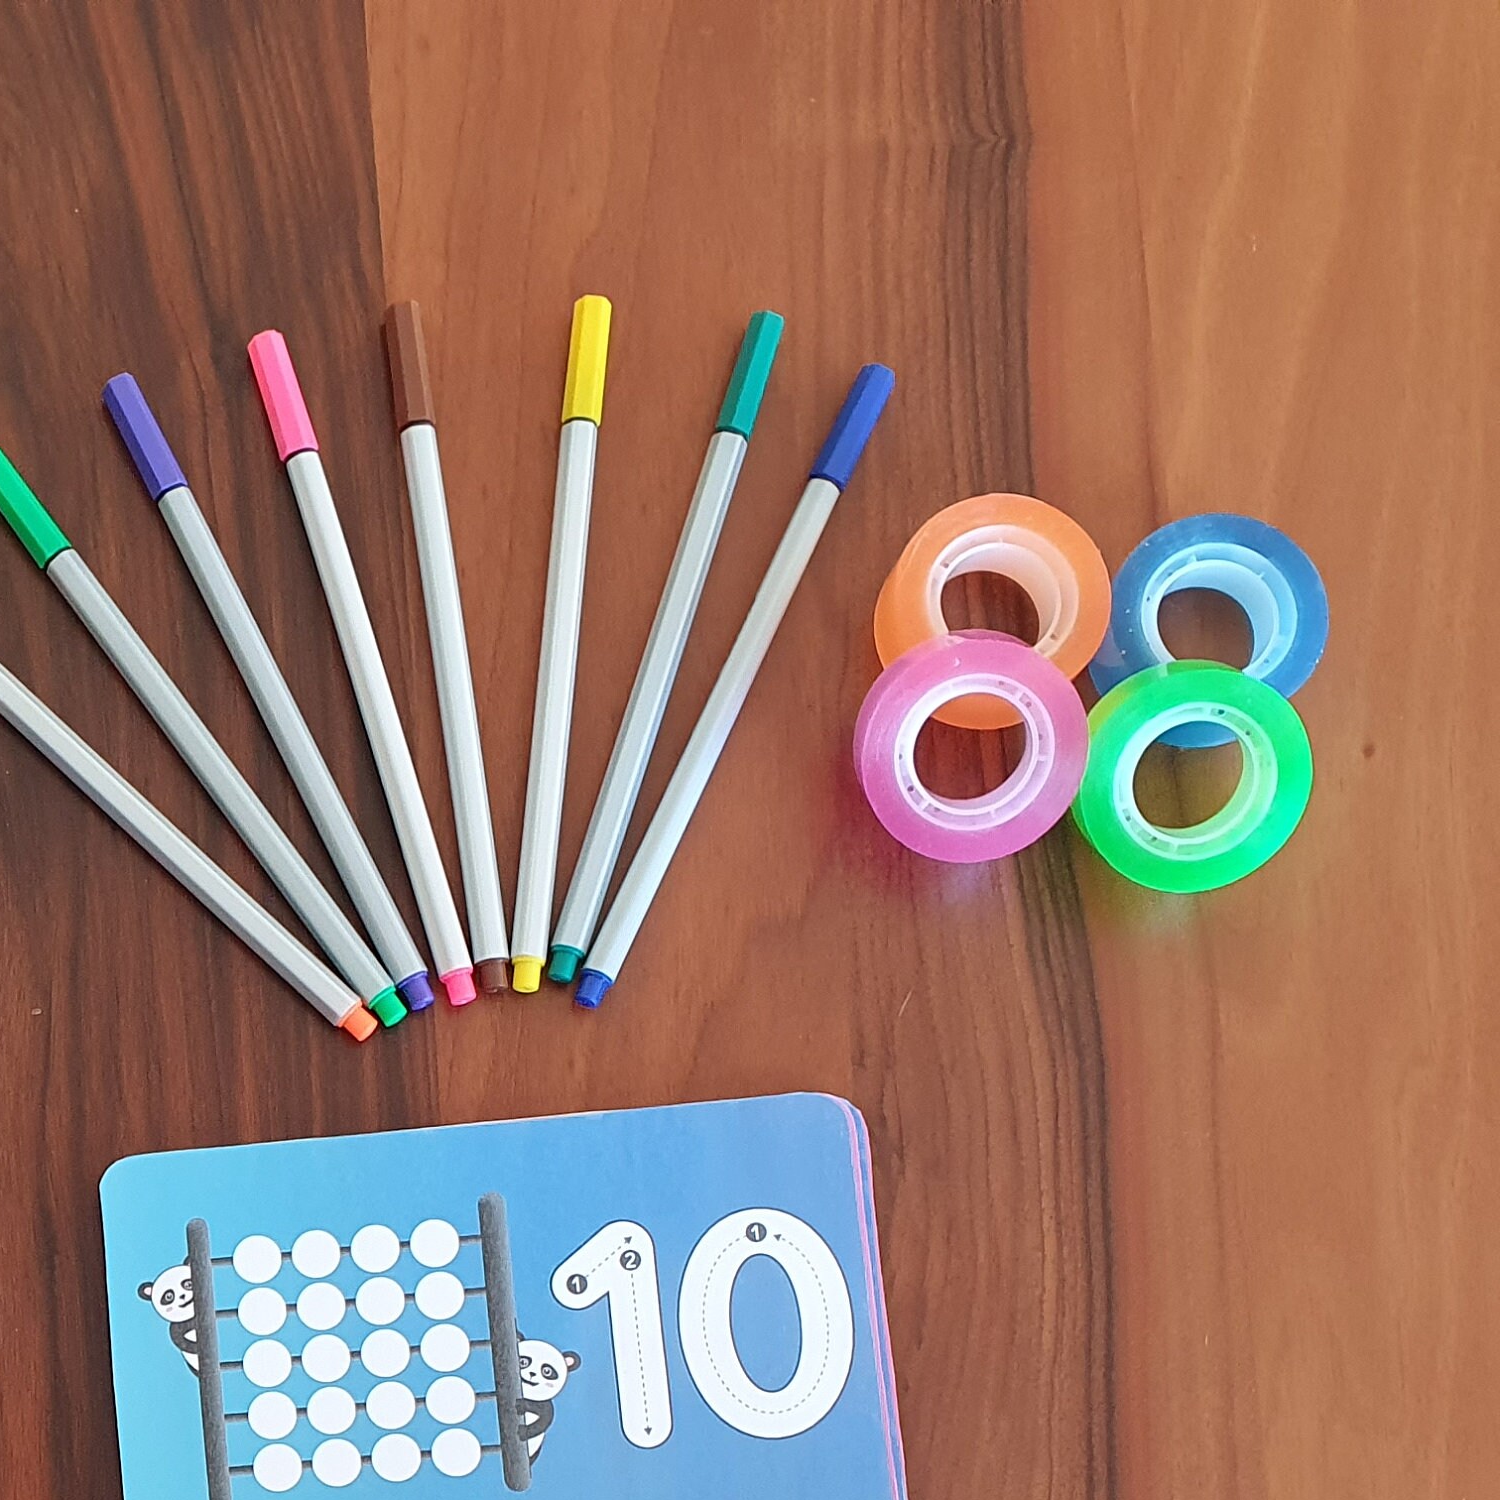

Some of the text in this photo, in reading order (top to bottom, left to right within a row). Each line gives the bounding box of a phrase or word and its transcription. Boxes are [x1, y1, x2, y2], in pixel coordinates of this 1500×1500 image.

[624, 1250, 637, 1269] 2
[571, 1275, 581, 1293] 1
[550, 1206, 855, 1449] 10
